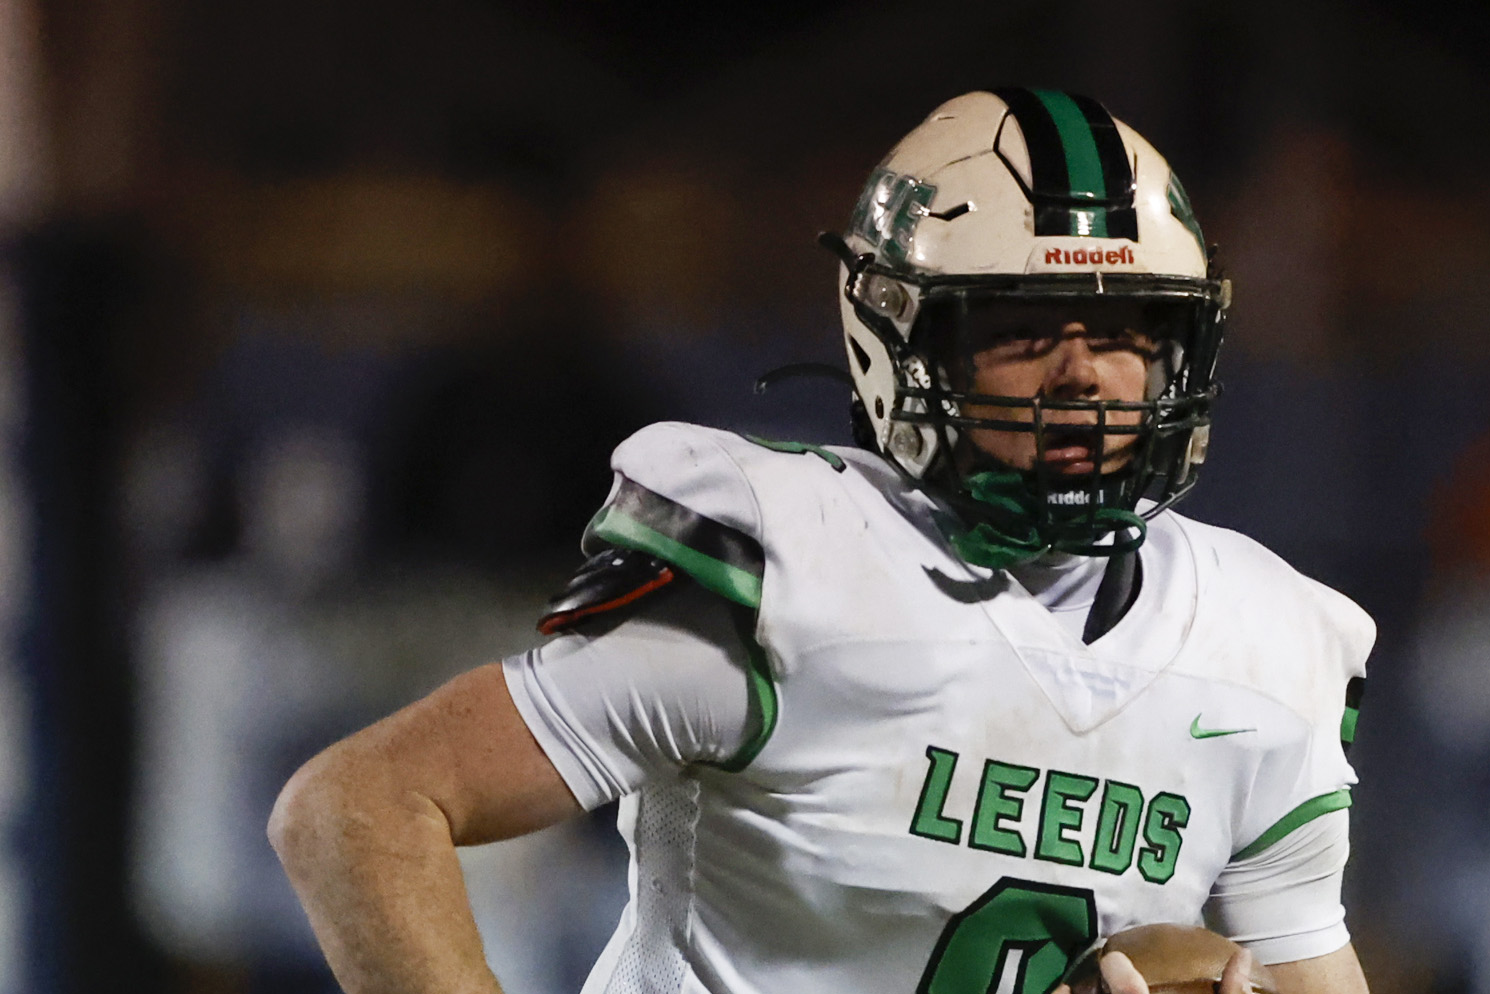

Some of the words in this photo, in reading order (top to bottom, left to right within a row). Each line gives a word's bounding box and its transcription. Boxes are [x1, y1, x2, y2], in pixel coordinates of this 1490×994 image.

[1045, 246, 1134, 265] Riddell
[1047, 490, 1104, 505] Riddl
[910, 745, 1190, 885] LEEDS
